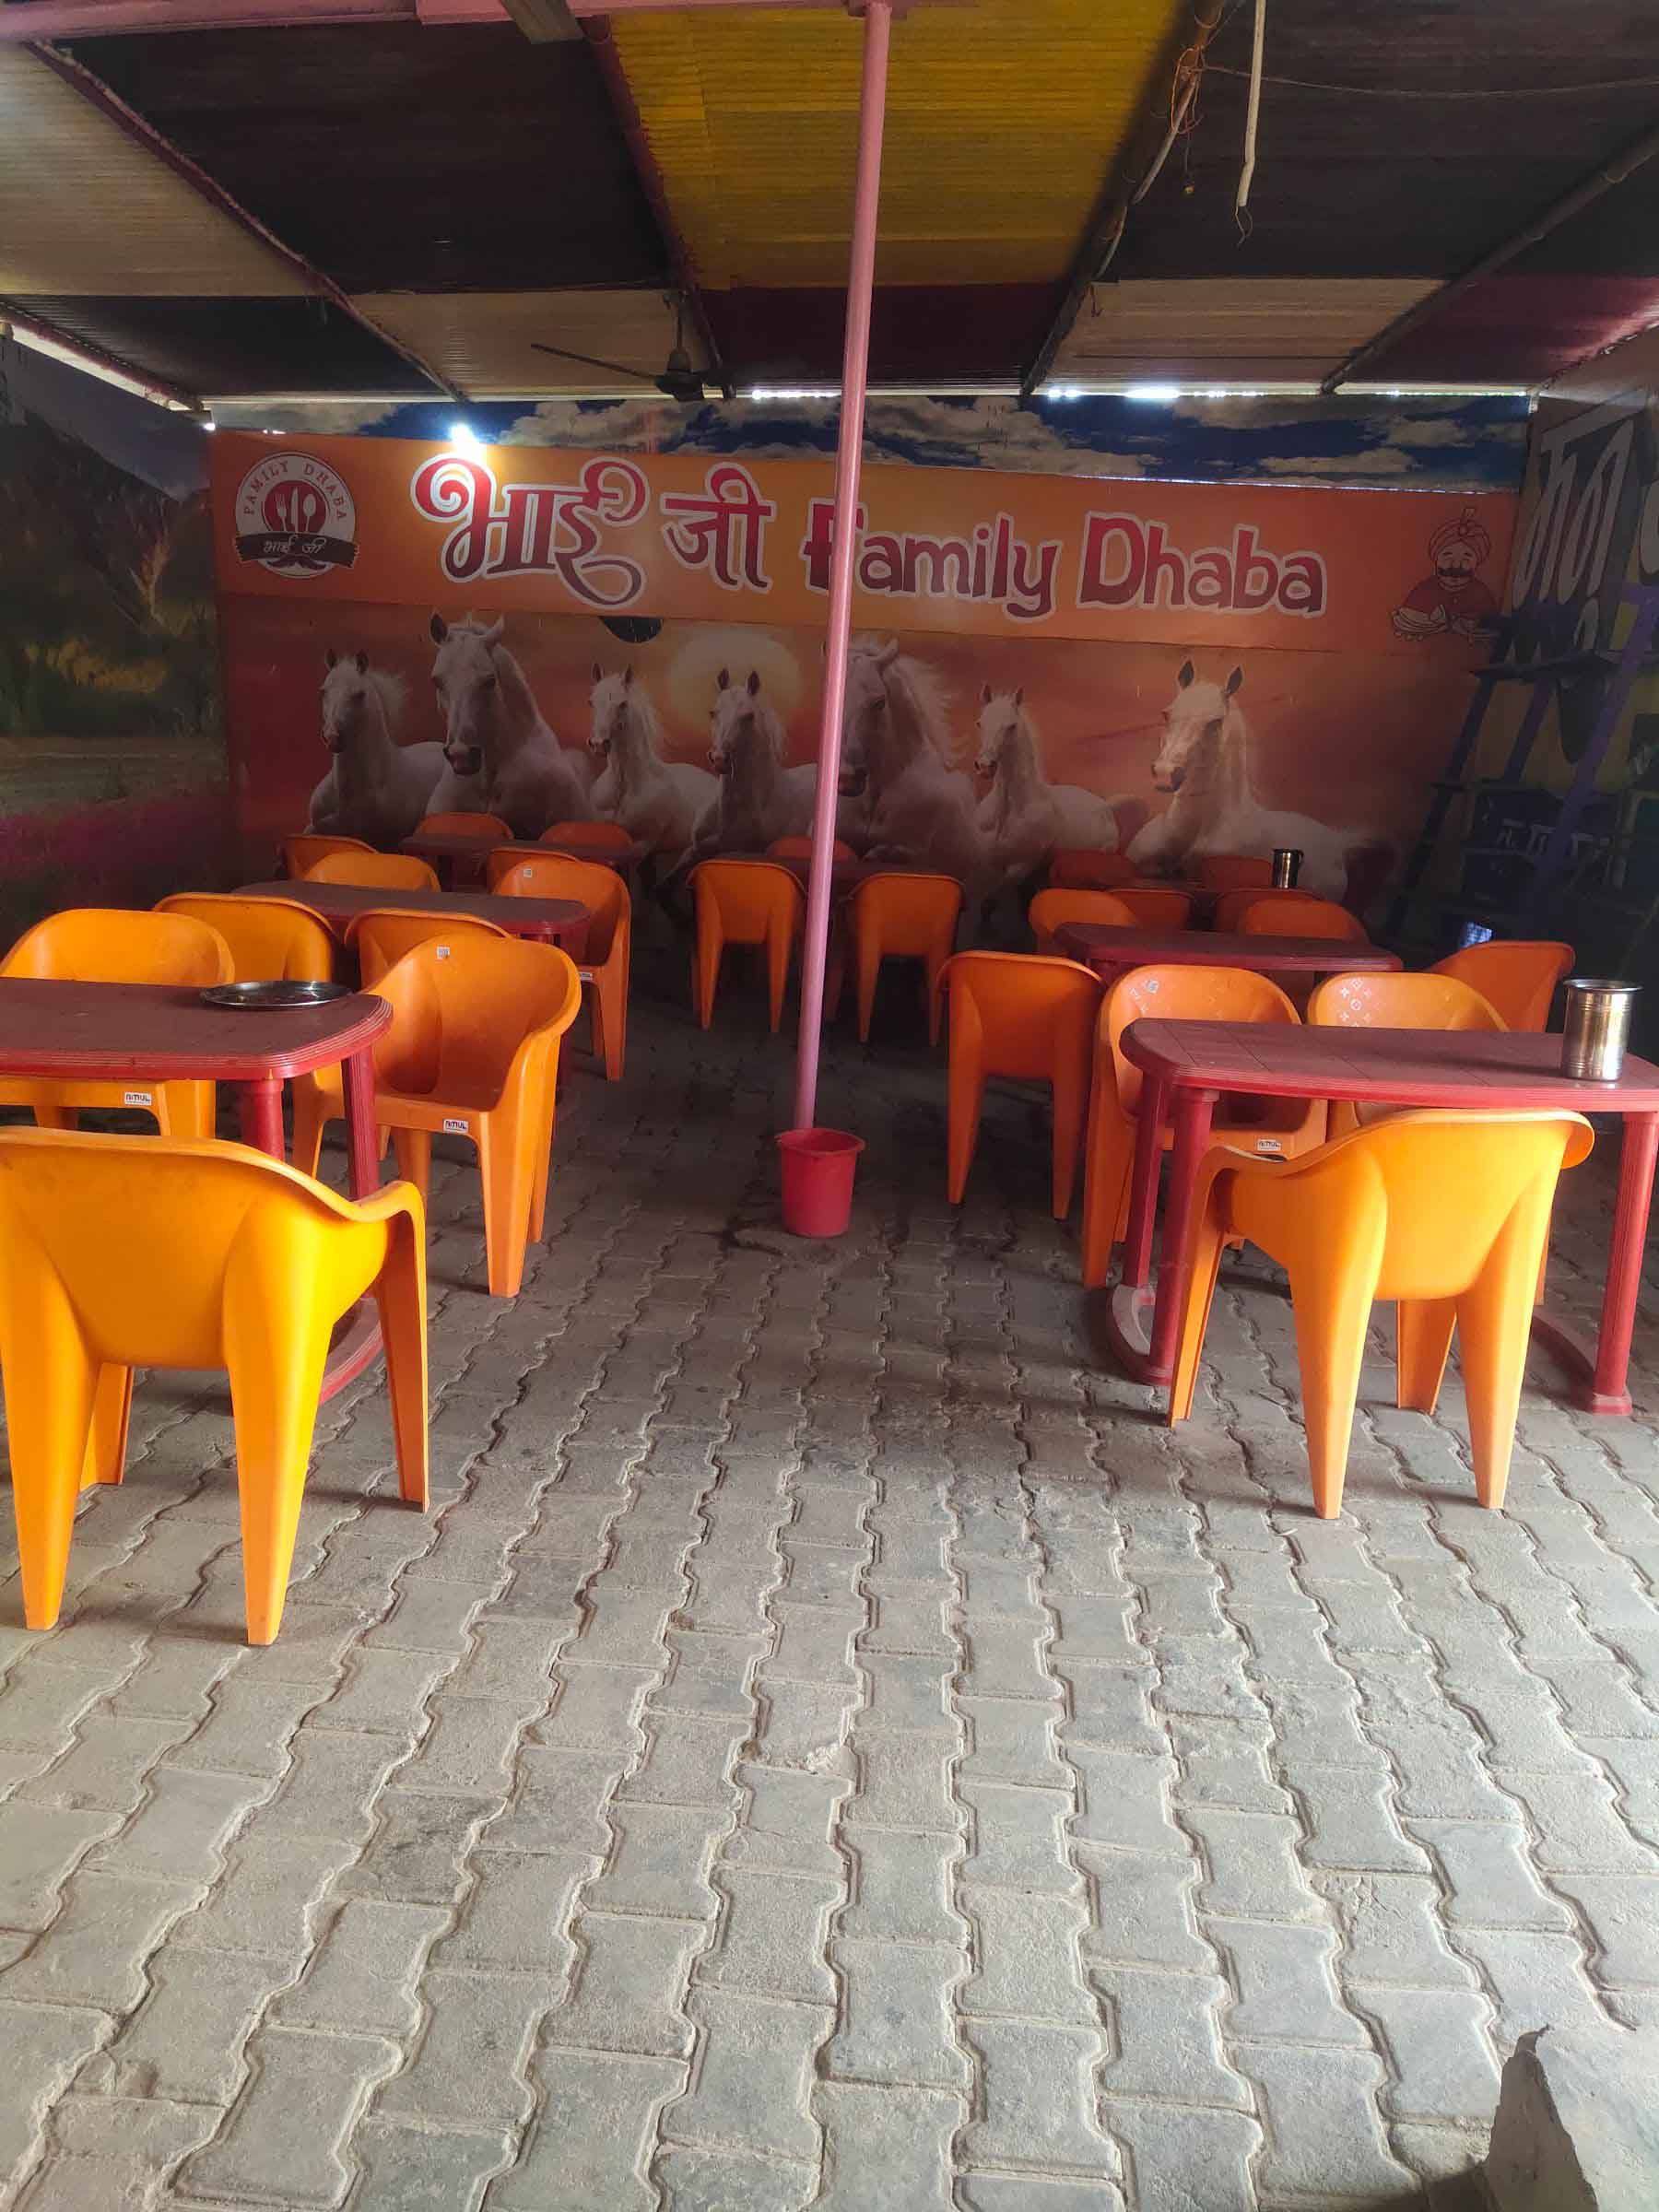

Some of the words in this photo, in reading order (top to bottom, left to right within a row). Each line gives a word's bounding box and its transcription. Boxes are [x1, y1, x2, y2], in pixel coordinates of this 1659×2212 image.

[243, 461, 289, 516] FAMILY
[303, 463, 347, 521] DHABA
[409, 451, 647, 609] भाई
[660, 461, 776, 593] जी
[1076, 511, 1329, 619] Dhaba
